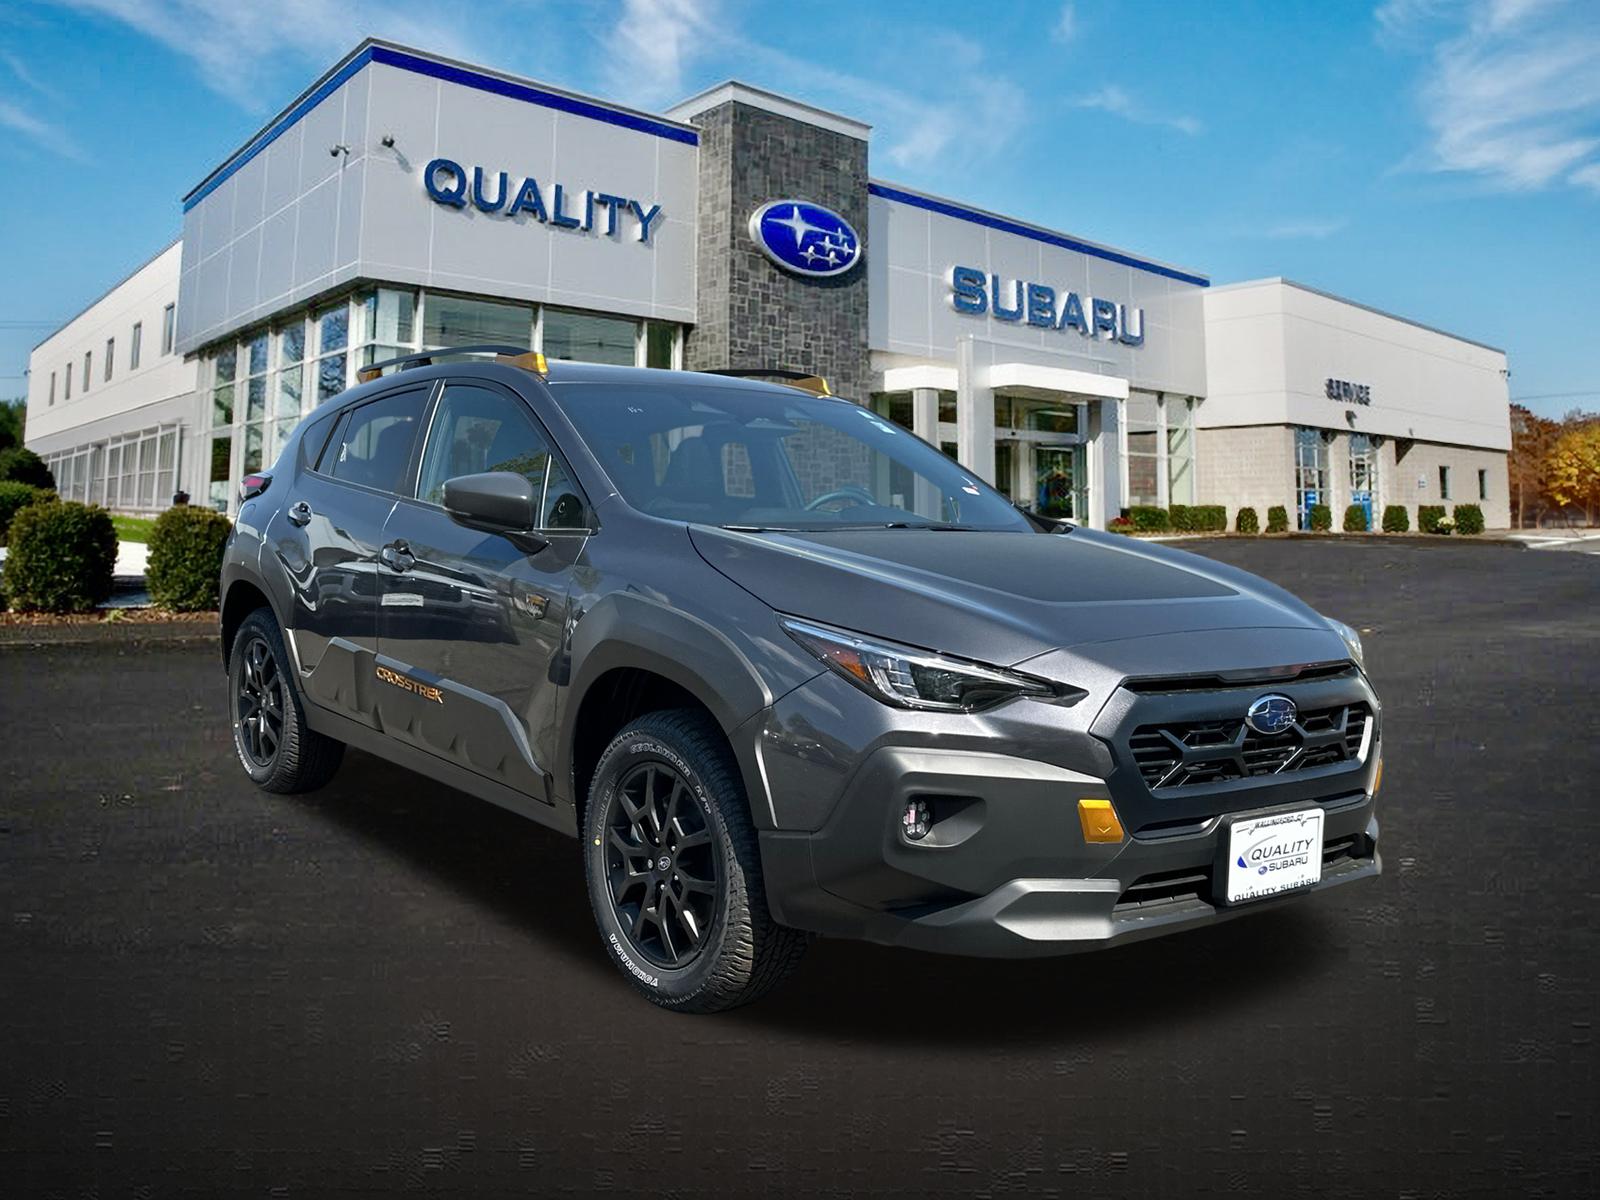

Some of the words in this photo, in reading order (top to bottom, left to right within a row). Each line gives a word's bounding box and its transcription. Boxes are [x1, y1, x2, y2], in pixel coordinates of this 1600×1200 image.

[423, 157, 662, 243] QUALITY
[950, 264, 1145, 346] SUBARU
[1325, 378, 1370, 406] SERVICE
[376, 666, 444, 704] CROSSTREK
[1251, 838, 1314, 861] QUALITY
[1269, 856, 1308, 871] SUBARU
[1234, 886, 1277, 901] QUALITY
[1280, 877, 1318, 892] SUBARU
[609, 933, 659, 987] YOKOHAMA
